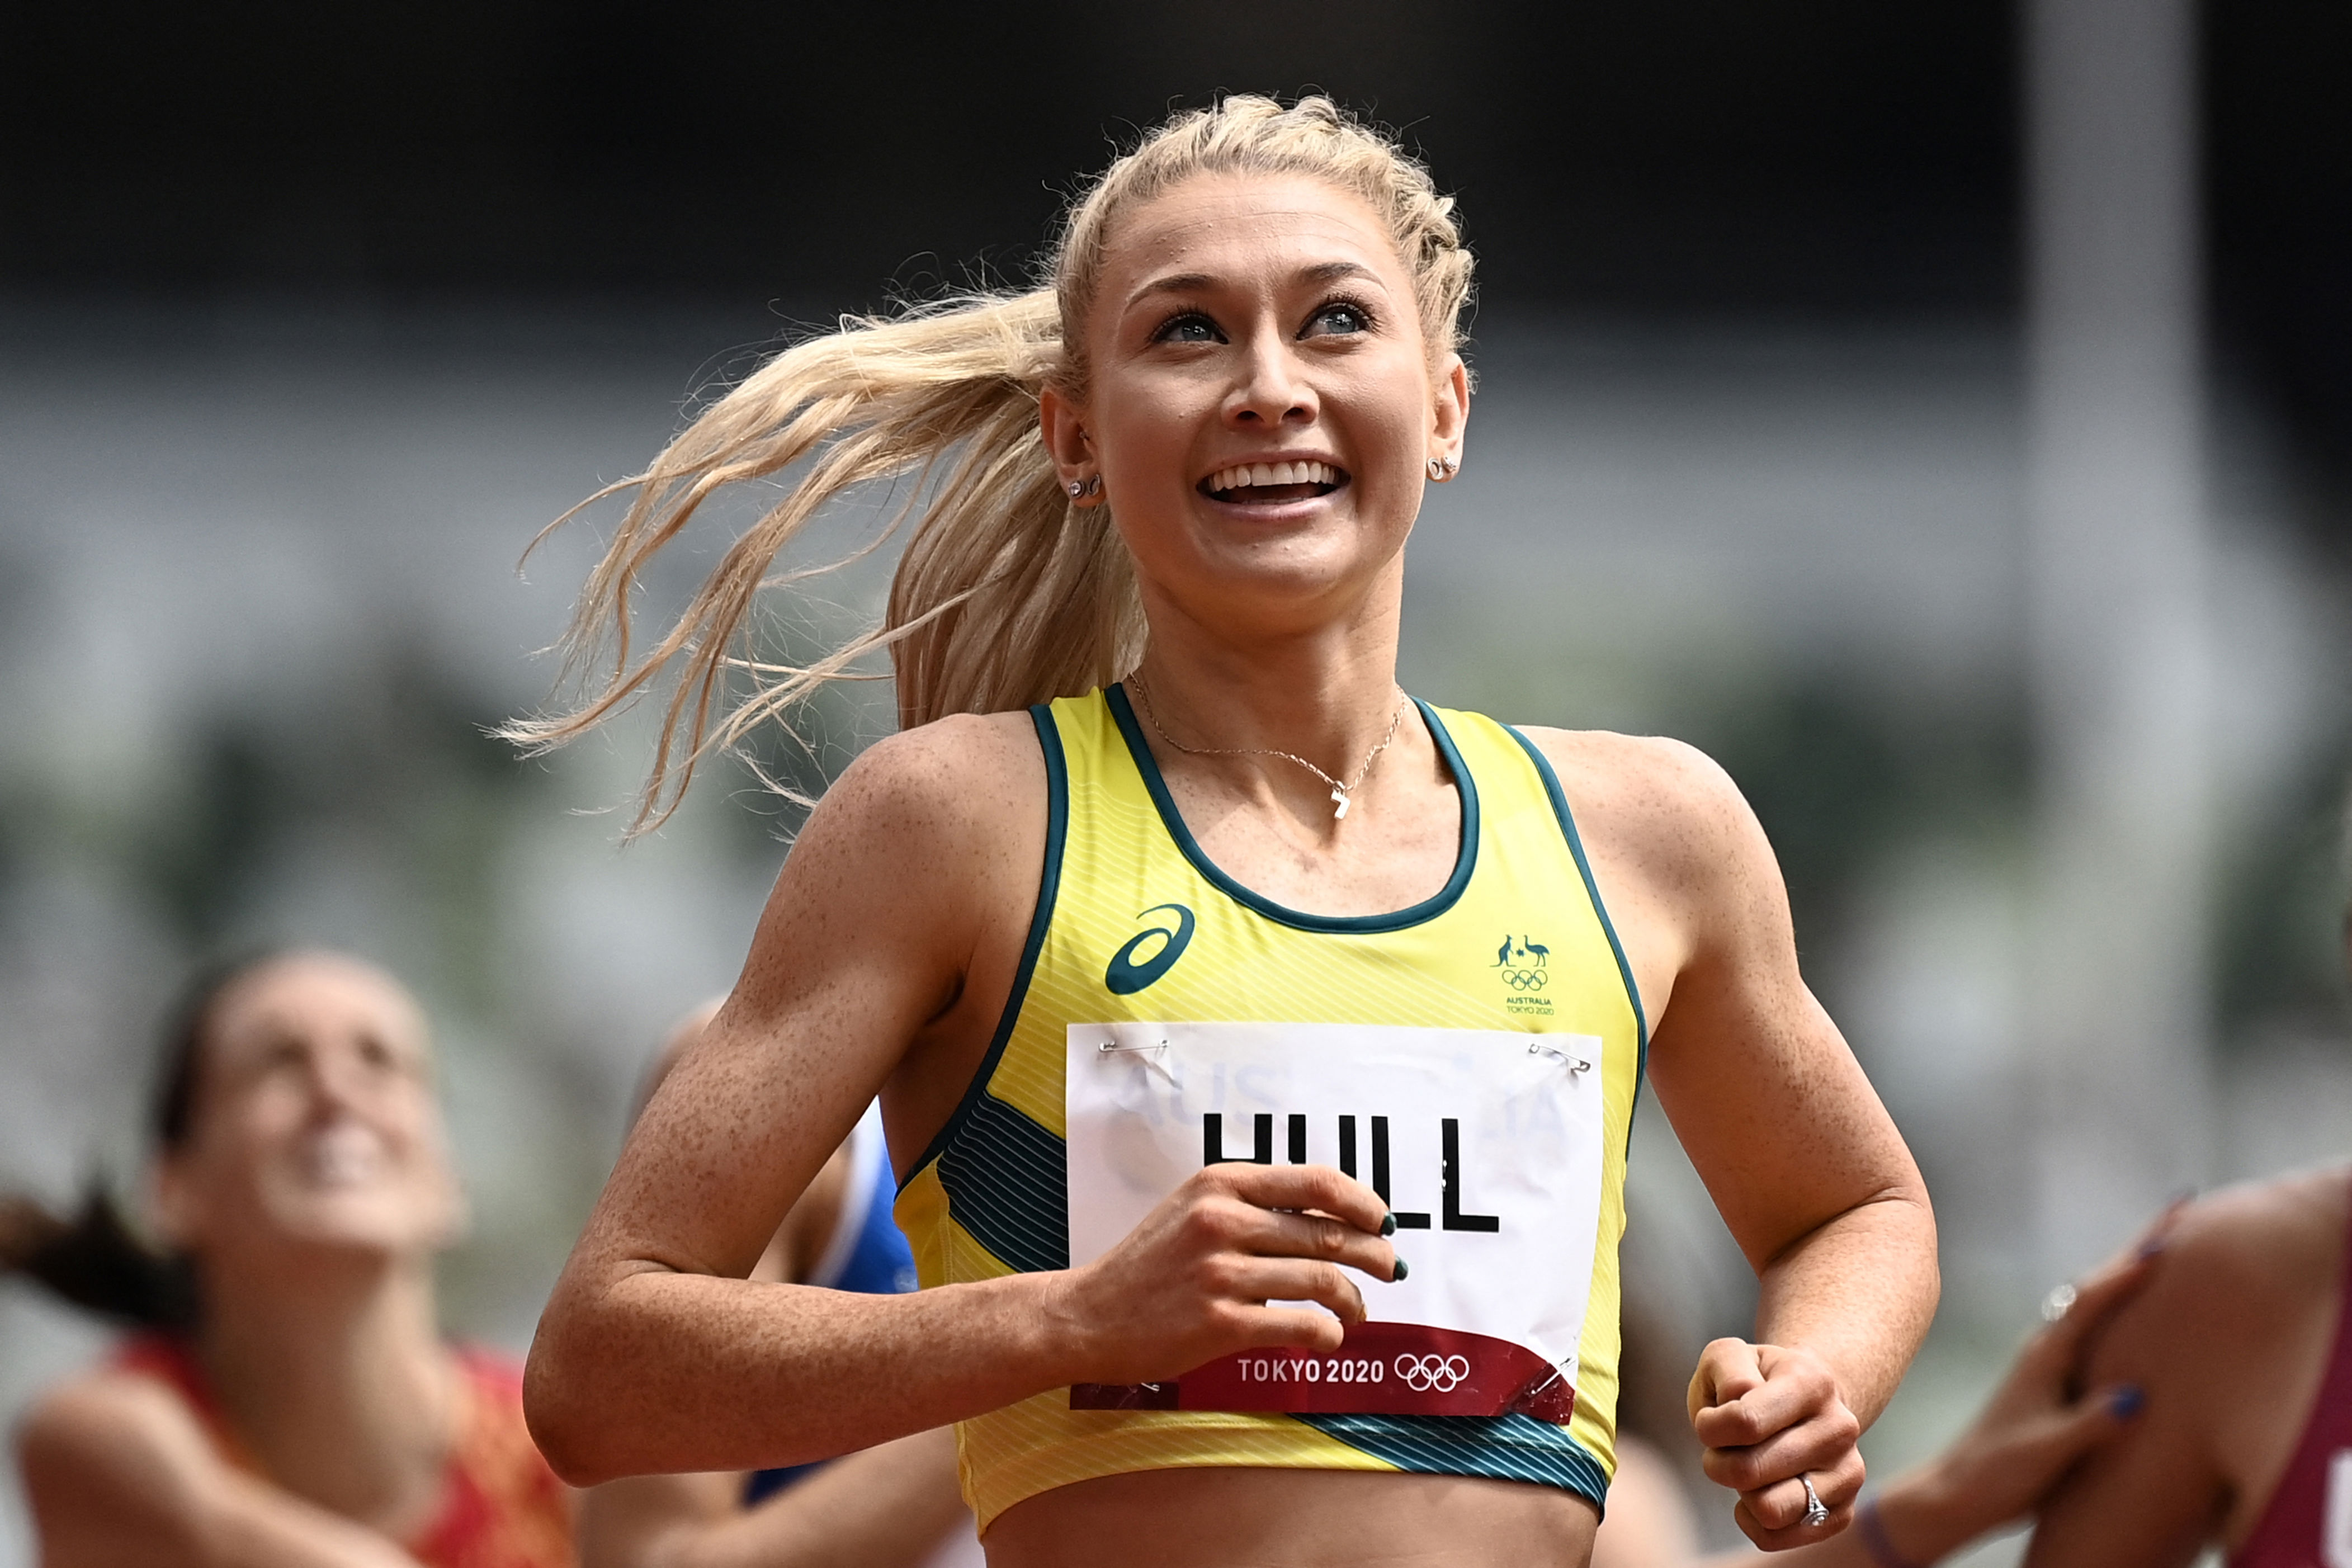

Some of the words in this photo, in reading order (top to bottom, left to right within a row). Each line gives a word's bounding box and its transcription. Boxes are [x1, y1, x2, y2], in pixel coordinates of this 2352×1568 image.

[1506, 997, 1552, 1006] AUSTRALIA
[1506, 1005, 1534, 1014] TOKYO
[1536, 1007, 1554, 1016] 2020
[1237, 1359, 1320, 1382] TOKYO
[1326, 1359, 1384, 1383] 2020
